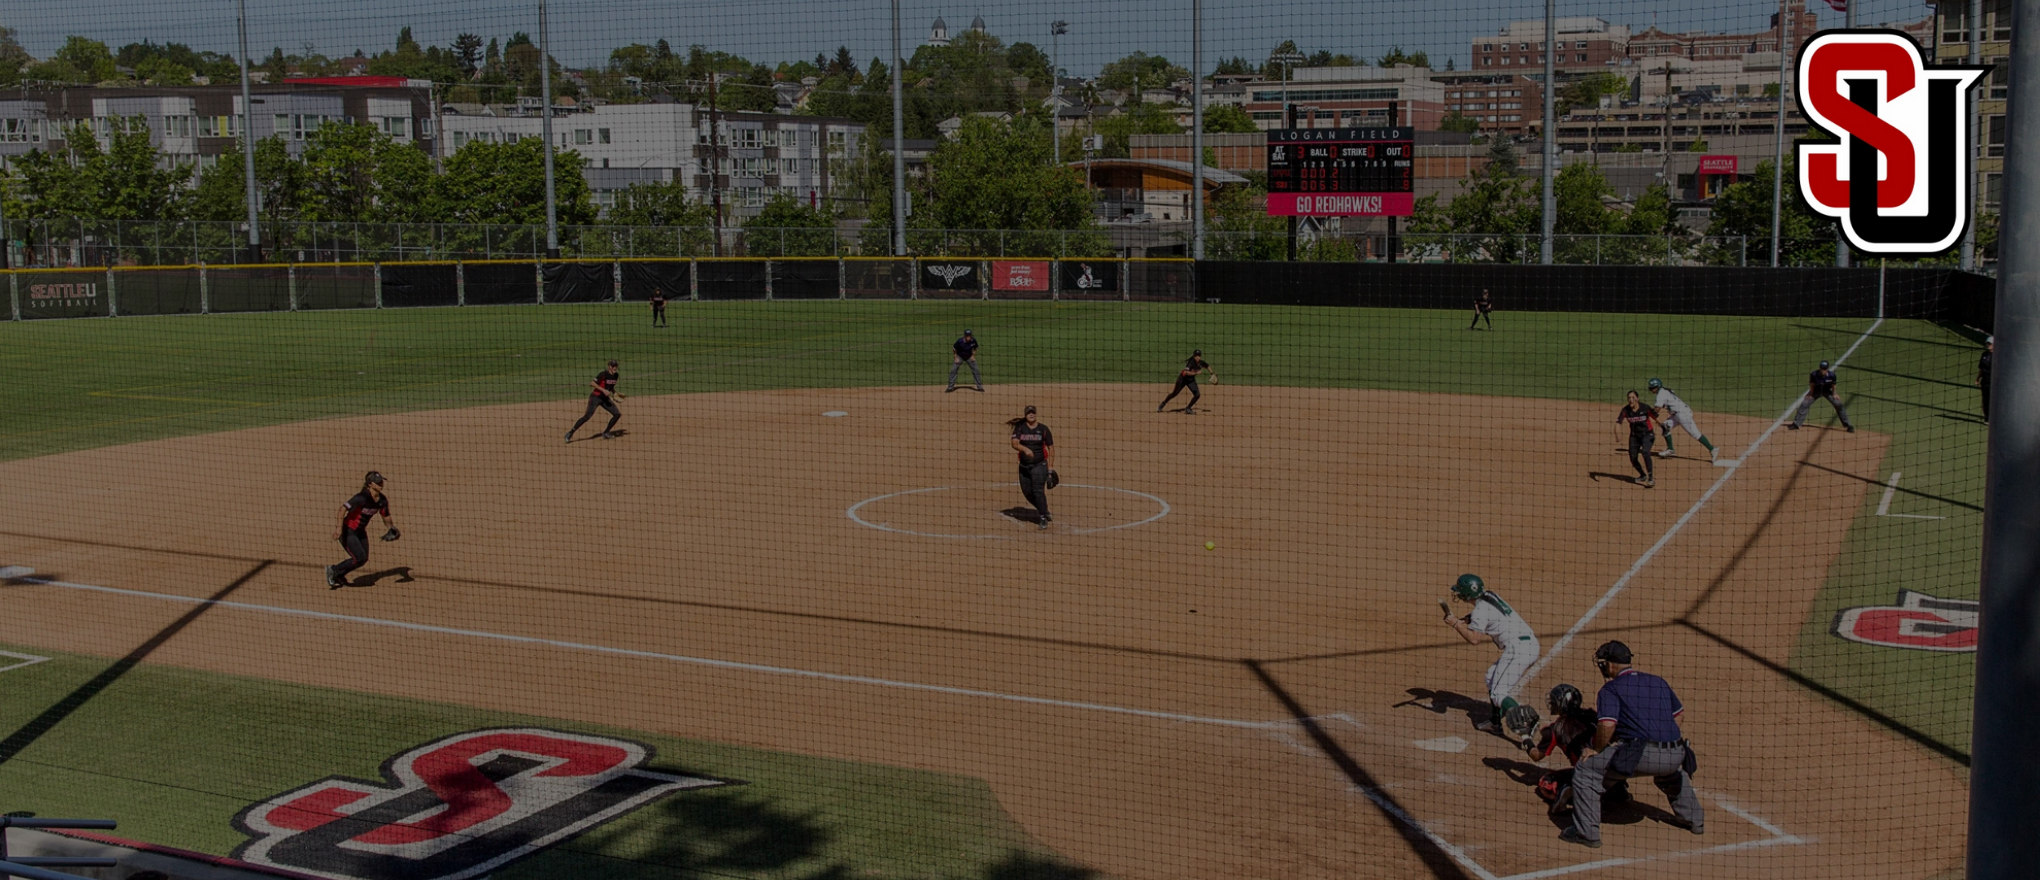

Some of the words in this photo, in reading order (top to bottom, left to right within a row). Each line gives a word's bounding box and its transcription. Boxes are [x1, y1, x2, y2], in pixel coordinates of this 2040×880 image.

[1280, 131, 1336, 140] LOGAN
[1351, 130, 1400, 139] FIELD
[1310, 148, 1328, 156] BALL
[1342, 148, 1367, 156] STRIKE
[1386, 148, 1402, 156] OUT
[1296, 196, 1312, 213] GO
[1316, 196, 1382, 213] REDHAWKS!
[31, 299, 97, 308] SOFTBALL
